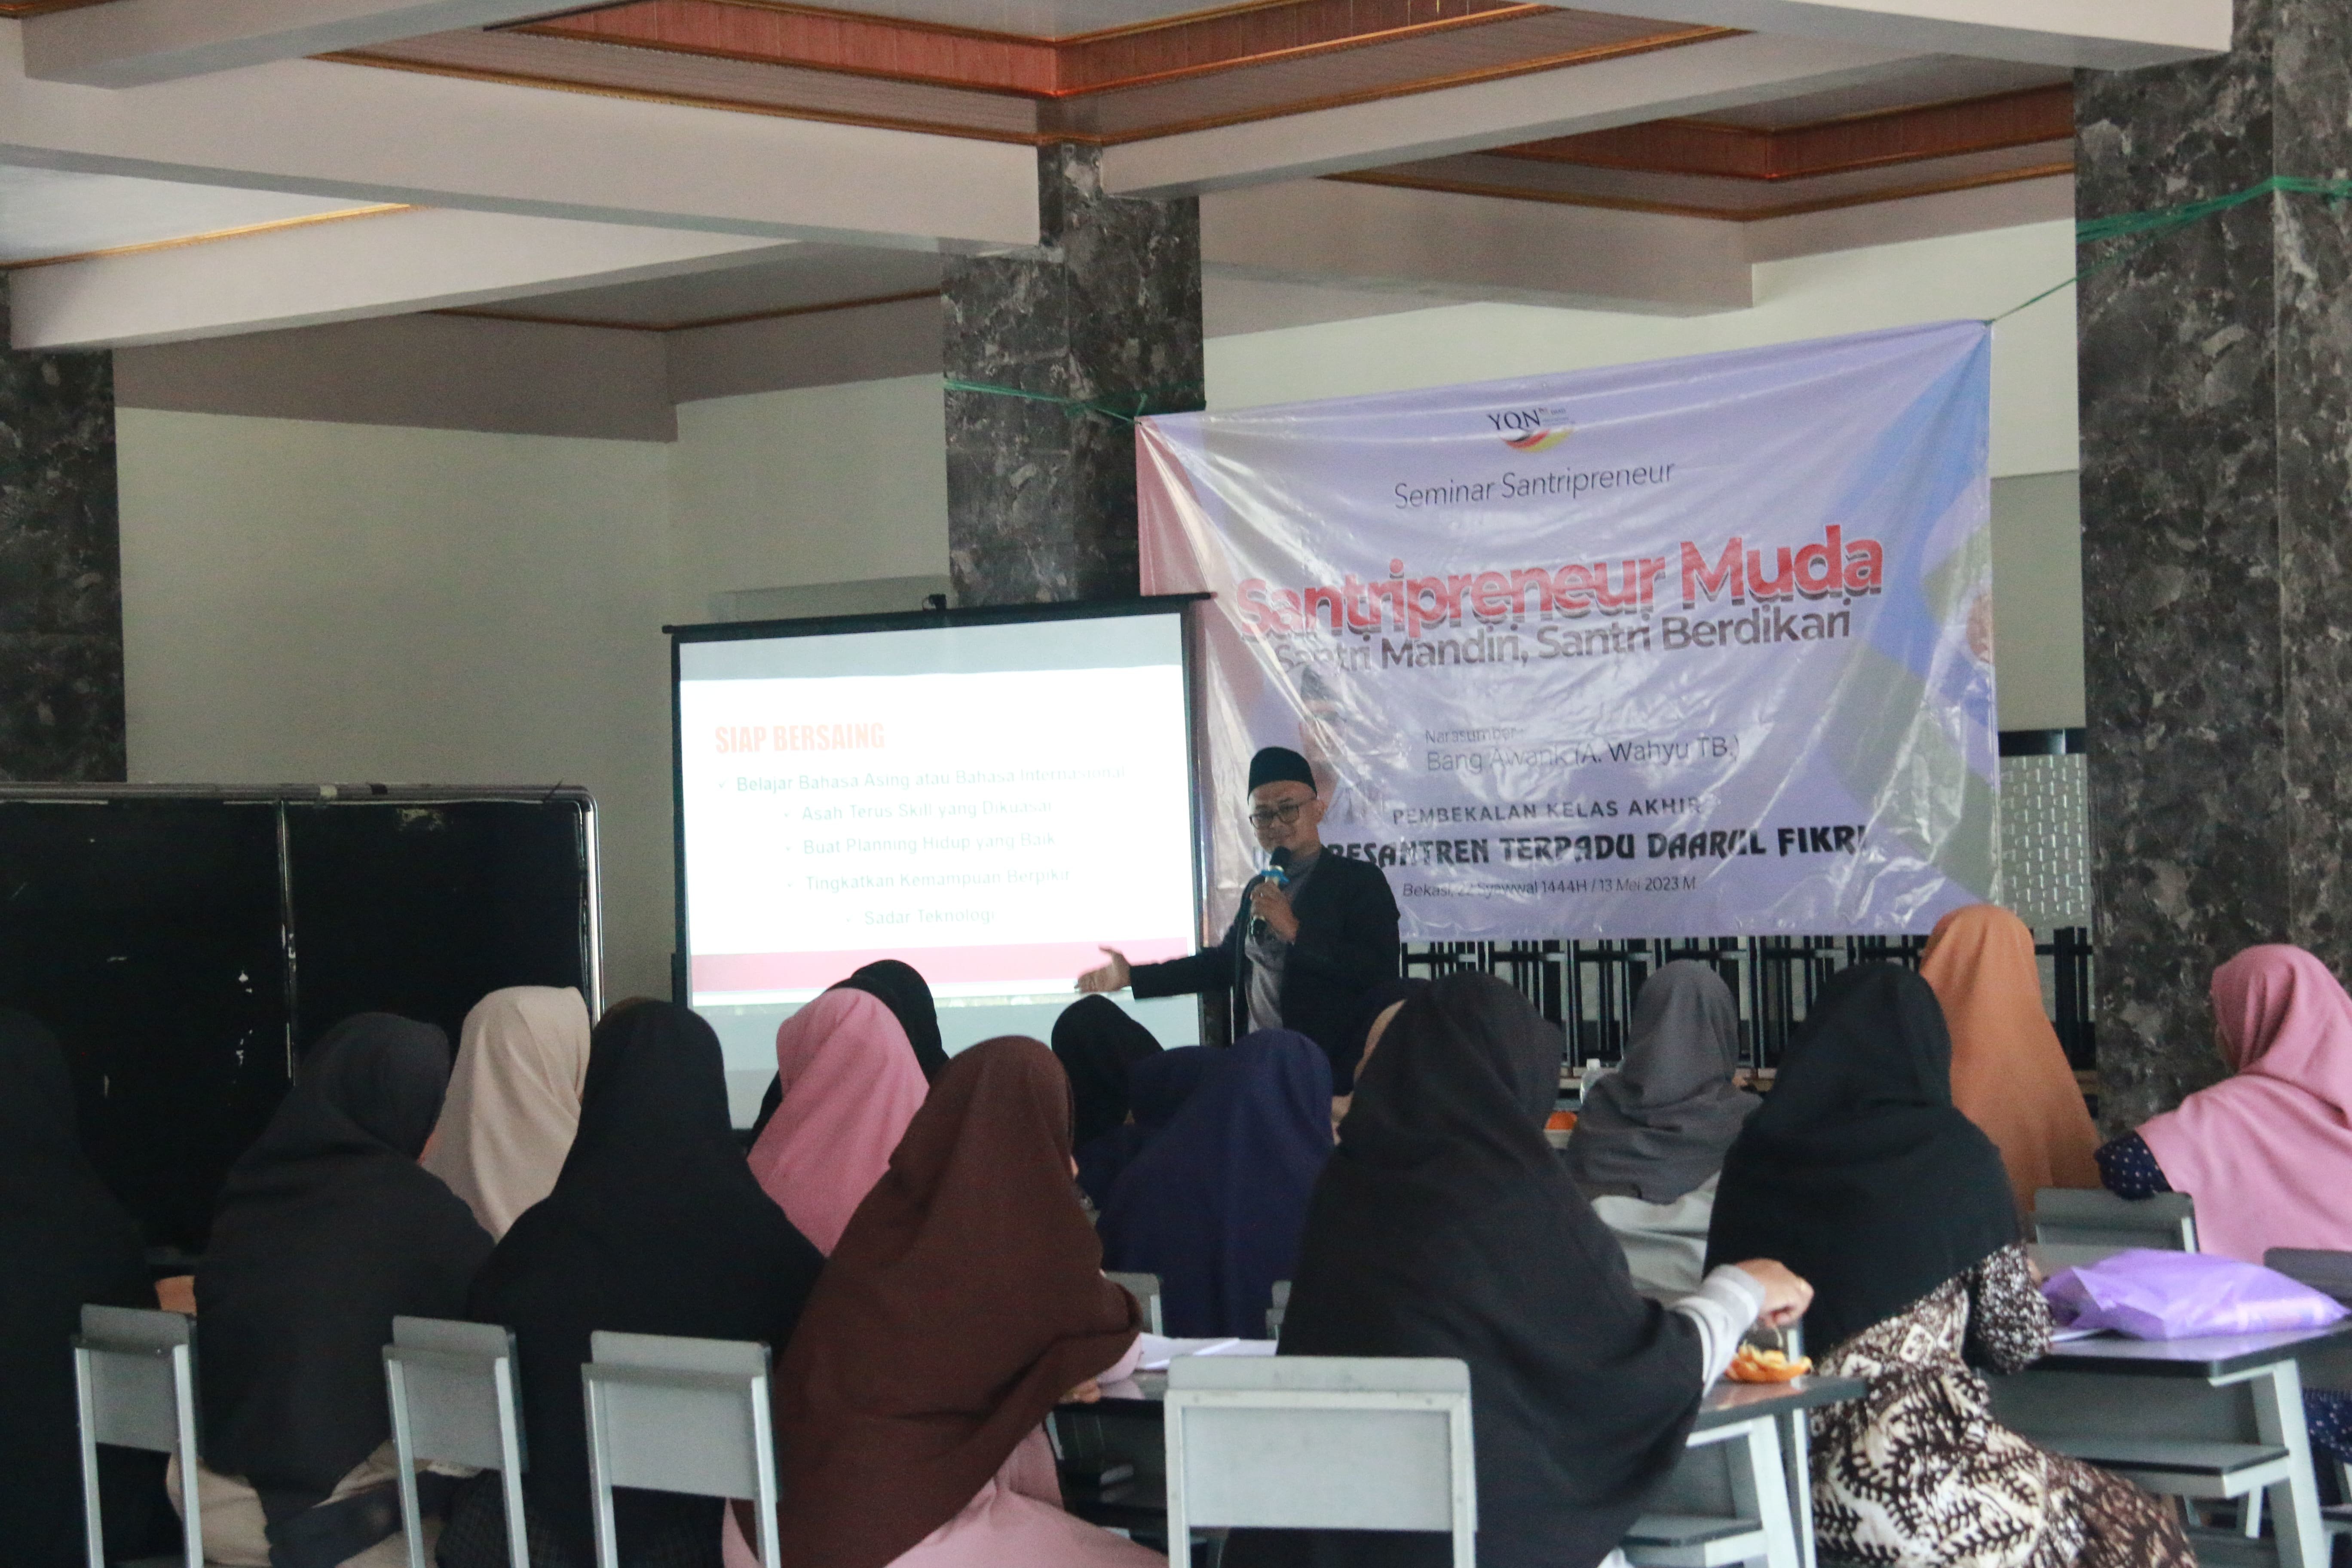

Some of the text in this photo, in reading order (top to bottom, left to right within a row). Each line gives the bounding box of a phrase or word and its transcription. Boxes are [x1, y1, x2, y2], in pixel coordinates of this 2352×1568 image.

[1488, 409, 1540, 430] YQN
[1394, 462, 1675, 509] Seminar Santripreneur
[1236, 524, 1883, 641] Santripreneur Muda
[1381, 623, 1529, 669] Mandiri,
[1537, 613, 1652, 658] Santri
[1662, 597, 1852, 651] Berdikari
[715, 721, 885, 753] SIAP BERSAING
[1427, 751, 1482, 774] Bang
[1607, 740, 1688, 766] Wahyu
[737, 776, 793, 794] Belajar
[799, 774, 859, 790] Bahasa
[864, 772, 910, 790] Asing
[916, 772, 950, 785] atau
[956, 769, 1015, 784] Bahasa
[802, 800, 1051, 821] Asah Terus Skill yang Dikuasai
[1393, 796, 1701, 825] PEMBEKALAN KELAS AKHIR
[804, 832, 1054, 854] Buat Planning Hidup yang Baik
[1499, 832, 1634, 862] TERPADU
[806, 869, 1069, 894] Tingkatkan Kemampuan Berpikir
[1541, 879, 1587, 894] 1444H
[1600, 878, 1613, 891] 13
[1616, 877, 1641, 891] Mei
[1645, 876, 1679, 891] 2023
[1683, 875, 1696, 891] M
[864, 908, 994, 925] Sadar Teknologi
